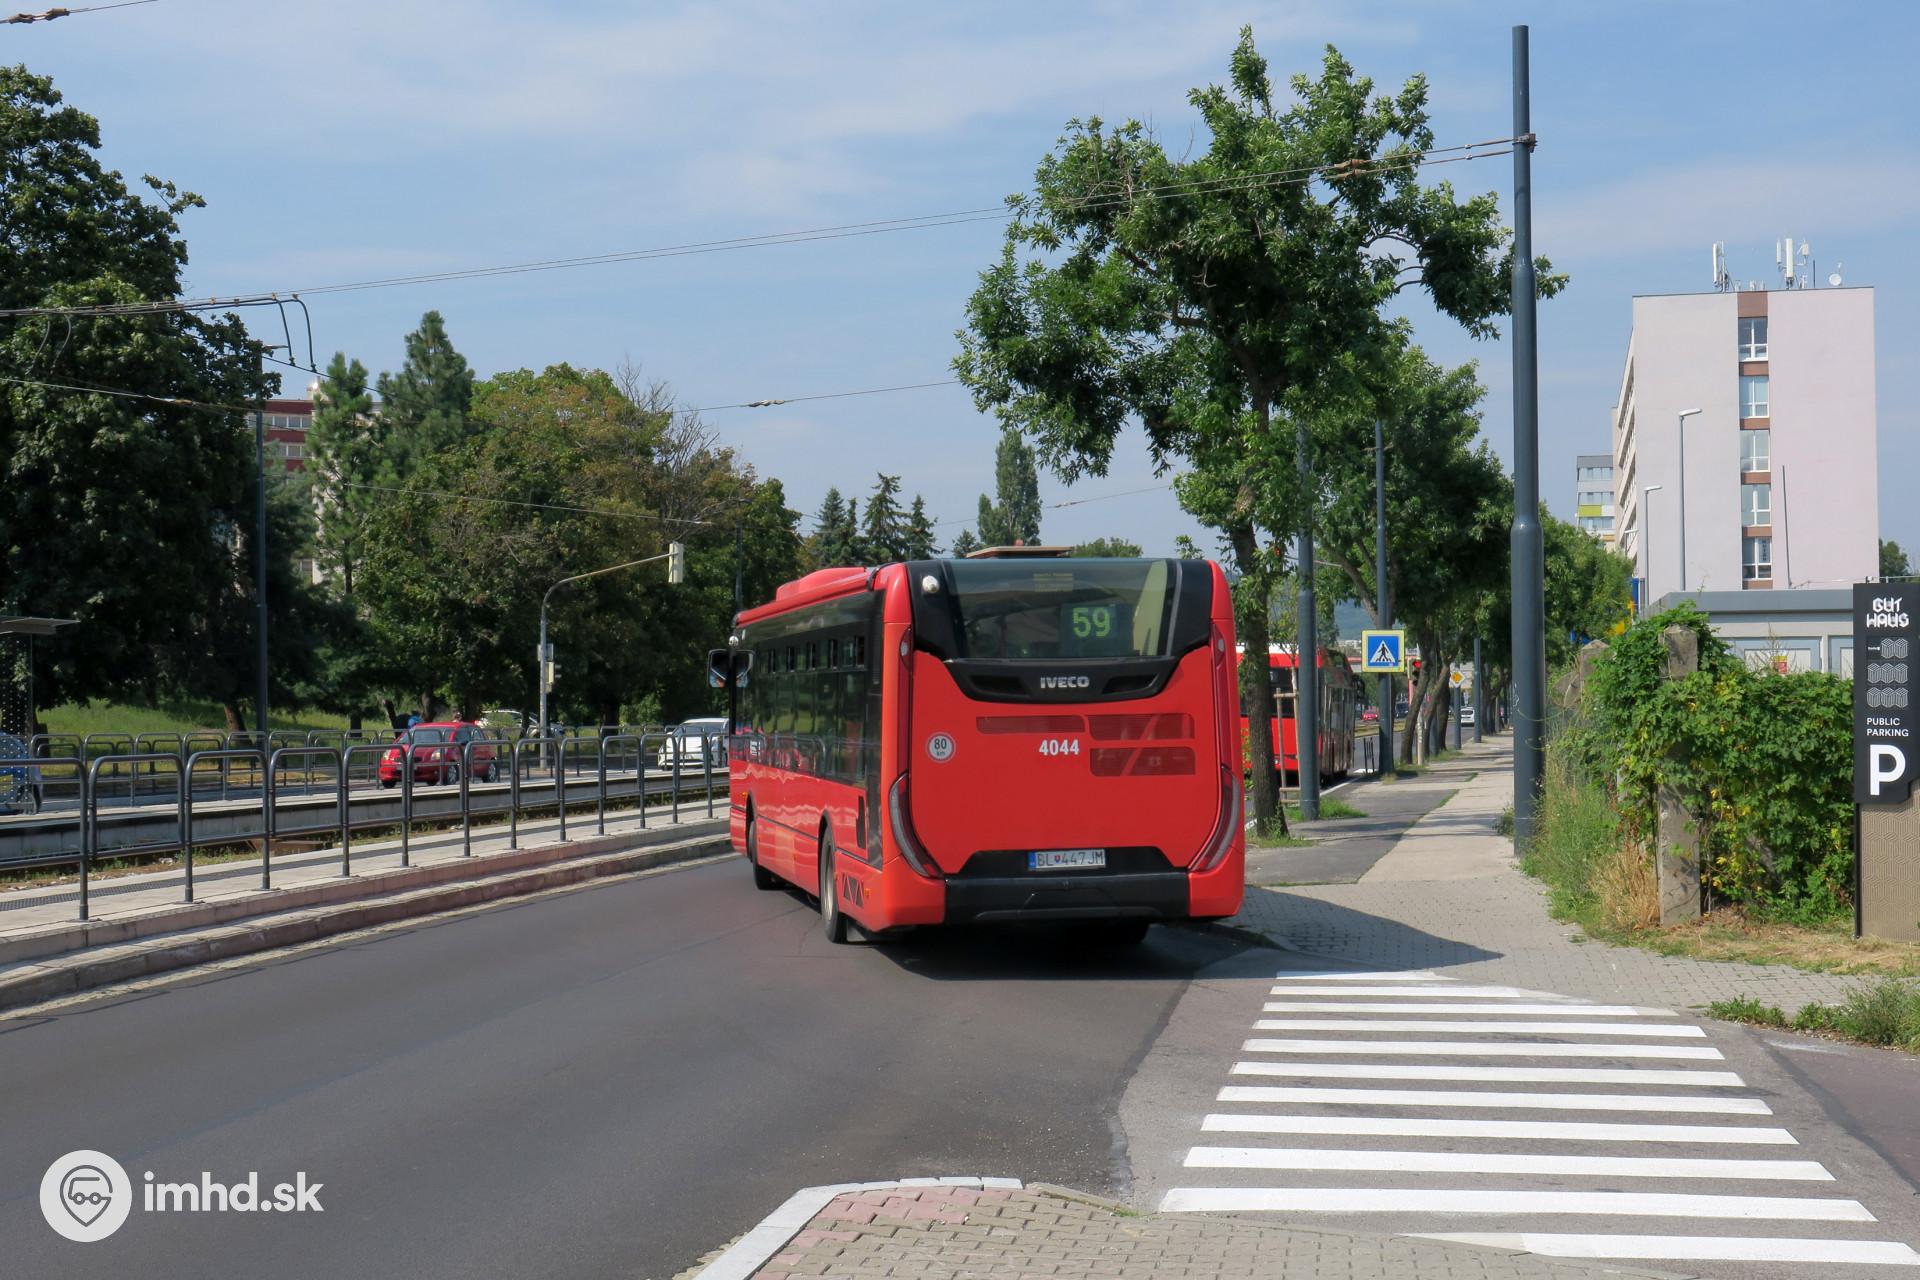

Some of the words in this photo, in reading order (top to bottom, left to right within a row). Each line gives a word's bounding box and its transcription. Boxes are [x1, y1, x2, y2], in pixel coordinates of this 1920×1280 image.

[1872, 597, 1902, 613] GUT
[1073, 607, 1110, 638] 59
[1866, 612, 1909, 628] HAUS
[1040, 676, 1090, 689] IVECO
[1867, 718, 1900, 726] PUBLIC
[1867, 728, 1910, 737] PARKING
[934, 738, 947, 750] 80
[1039, 739, 1079, 756] 4044
[1870, 744, 1906, 796] P
[1037, 853, 1054, 867] BL
[1062, 851, 1104, 865] 447JM
